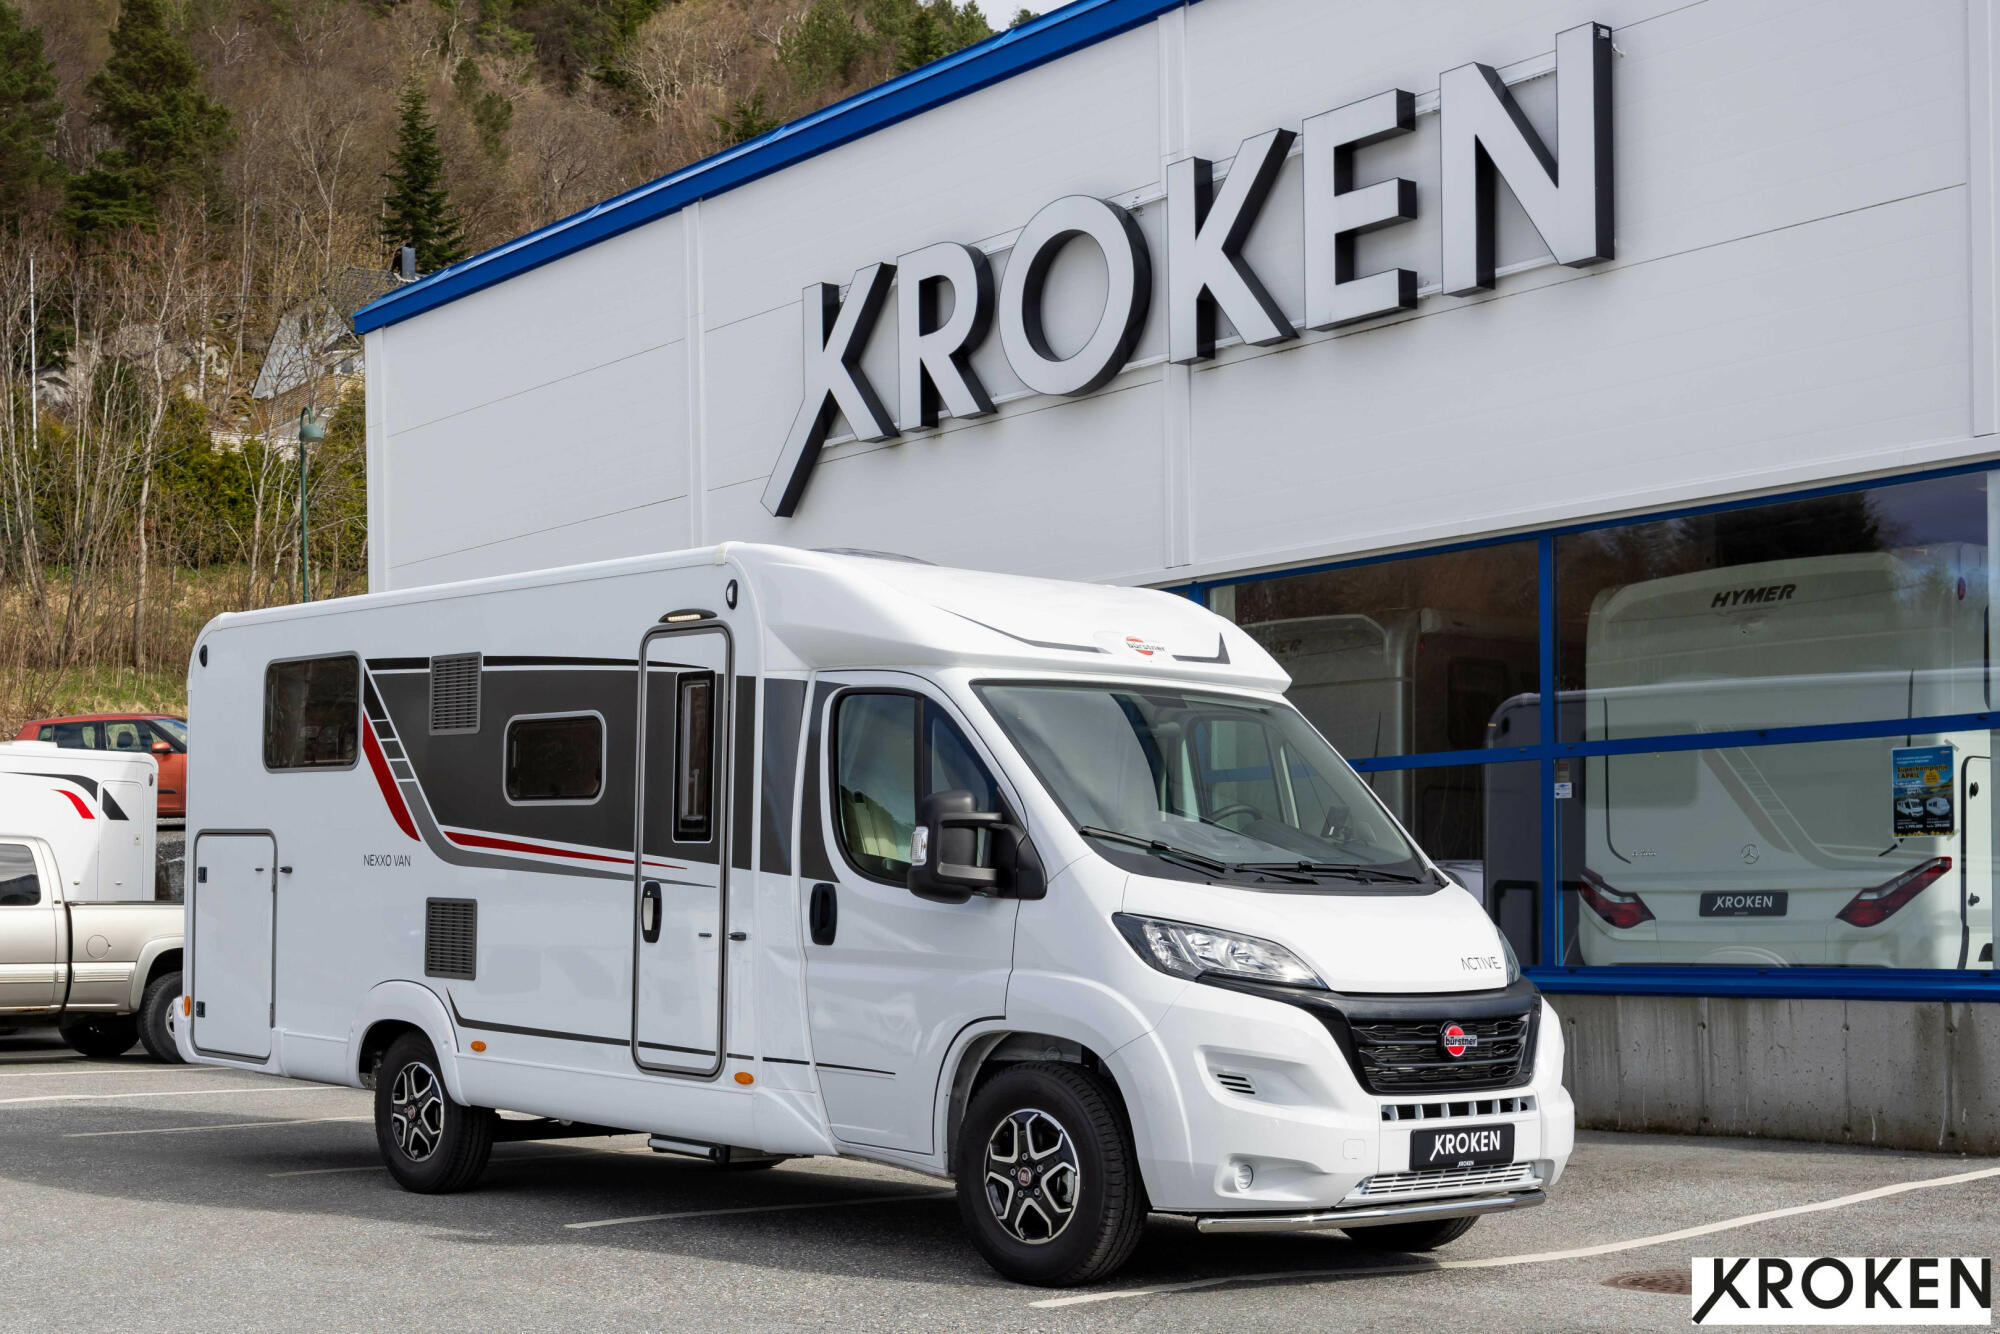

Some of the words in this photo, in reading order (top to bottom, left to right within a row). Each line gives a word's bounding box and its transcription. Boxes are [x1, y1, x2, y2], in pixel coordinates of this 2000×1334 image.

[760, 21, 1615, 517] KROKEN
[1710, 584, 1797, 608] HYMER
[363, 854, 392, 867] NEXXO
[394, 854, 411, 867] VAN
[1712, 895, 1773, 911] KROKEN
[1461, 956, 1502, 970] ACTIVE
[1445, 1036, 1477, 1046] bürstner
[1429, 1130, 1500, 1162] KROKEN
